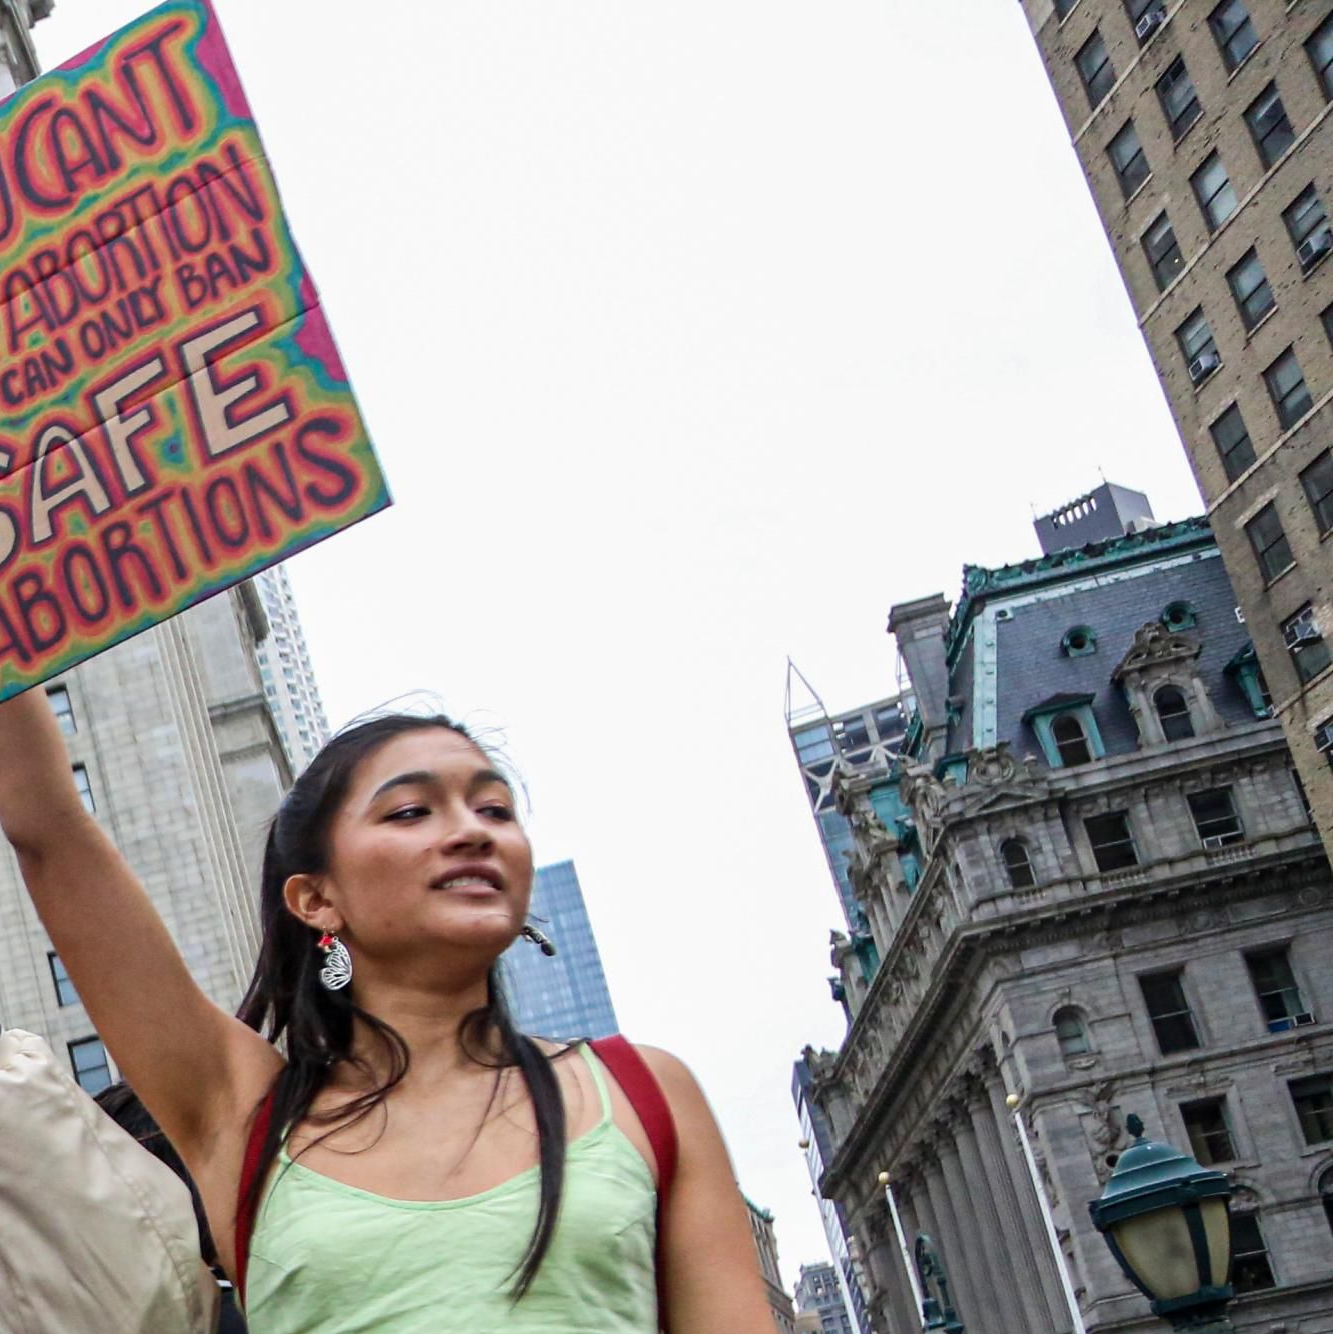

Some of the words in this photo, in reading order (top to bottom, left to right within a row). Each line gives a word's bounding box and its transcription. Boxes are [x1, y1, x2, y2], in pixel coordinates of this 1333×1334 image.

[14, 20, 197, 209] CANT
[0, 337, 74, 406] CAN
[84, 278, 161, 360] ONLY
[173, 228, 270, 308] BAN
[4, 142, 263, 365] ABORTION
